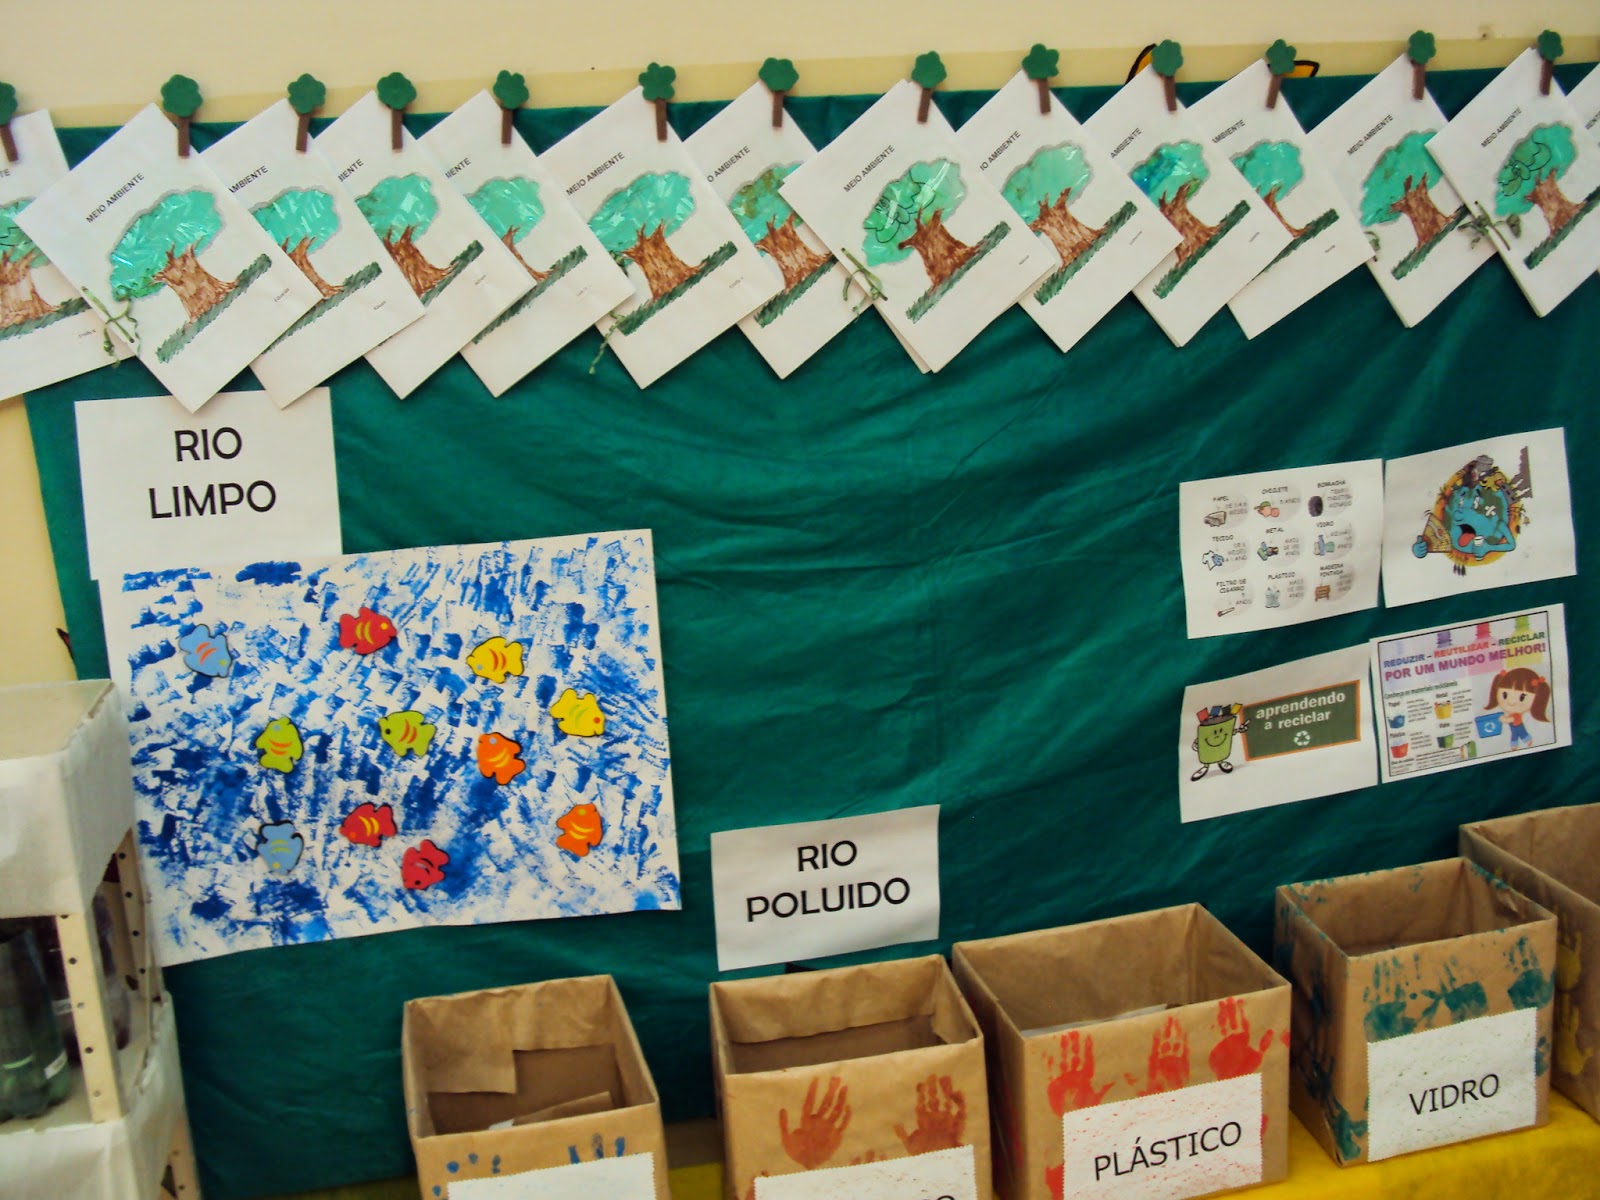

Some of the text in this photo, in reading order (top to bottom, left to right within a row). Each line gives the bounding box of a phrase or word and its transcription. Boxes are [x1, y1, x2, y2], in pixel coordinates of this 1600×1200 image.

[1110, 127, 1143, 159] AMBIENTE
[1347, 114, 1394, 156] MEIO AMBIENTE
[1481, 107, 1523, 148] MEIO AMBIENTE
[714, 145, 751, 177] AMBIENTE
[988, 130, 1021, 163] AMBIENTE
[444, 157, 471, 179] IENTE
[566, 152, 625, 196] MEIO AMBIENTE
[843, 145, 895, 193] MEIO AMBIENTE
[86, 172, 145, 224] MEIO AMBIENTE
[174, 426, 243, 462] RIO
[148, 480, 277, 519] LIMPO
[1212, 534, 1234, 542] TECIDO
[1316, 520, 1334, 528] VIDRO
[1216, 579, 1237, 587] FILTRO
[1383, 654, 1425, 668] REDUZIR
[1434, 642, 1489, 658] REUTILIZAR
[1498, 631, 1545, 646] RECICLAR
[1385, 642, 1546, 681] POR UM MUNDO MELHOR!
[1256, 691, 1346, 719] aprendendo
[1264, 711, 1331, 730] a reciclar
[797, 840, 858, 872] RIO
[746, 877, 911, 923] POLUIDO
[1409, 1073, 1500, 1116] VIDRO
[1094, 1121, 1242, 1181] PLÁSTICO
